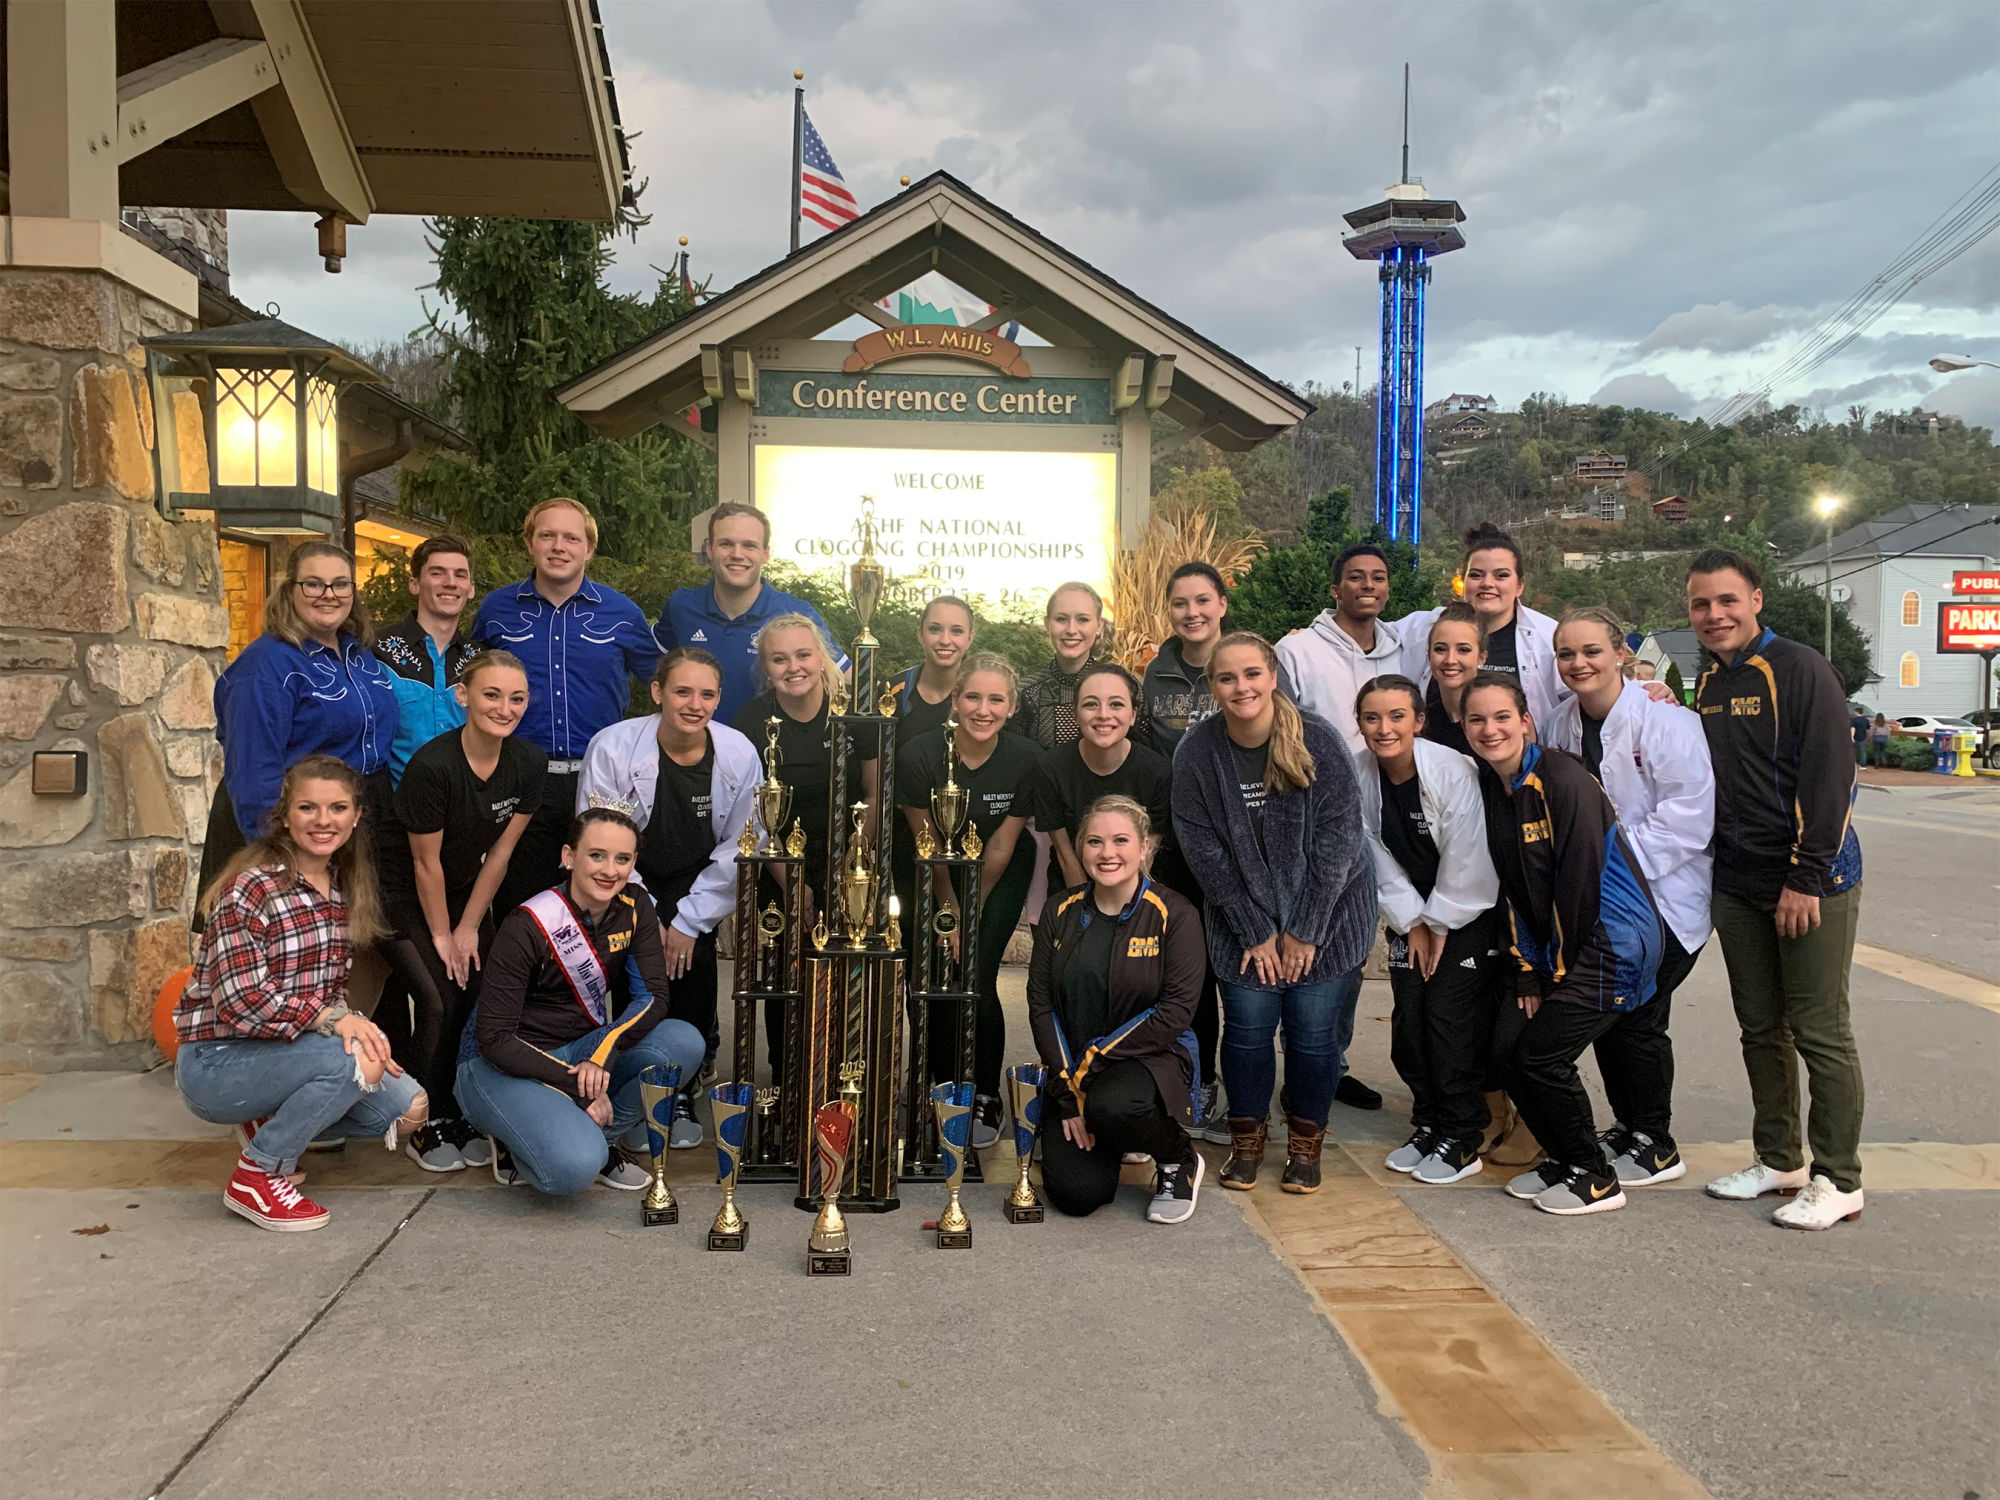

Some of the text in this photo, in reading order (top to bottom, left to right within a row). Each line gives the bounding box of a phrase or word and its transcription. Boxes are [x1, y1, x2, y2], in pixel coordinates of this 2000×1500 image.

[884, 329, 993, 355] W.L. Mills
[792, 380, 1077, 414] Conference Center
[894, 472, 985, 490] WELCOME
[919, 518, 1026, 536] NATIONAL
[795, 538, 1084, 559] CLOGGNG CHAMPIONSHIPS
[918, 563, 965, 580] 2019
[1000, 588, 1023, 604] 26
[1242, 791, 1266, 799] REAMS
[608, 930, 632, 953] BM
[839, 1060, 866, 1075] 2019
[755, 1086, 781, 1100] 2019
